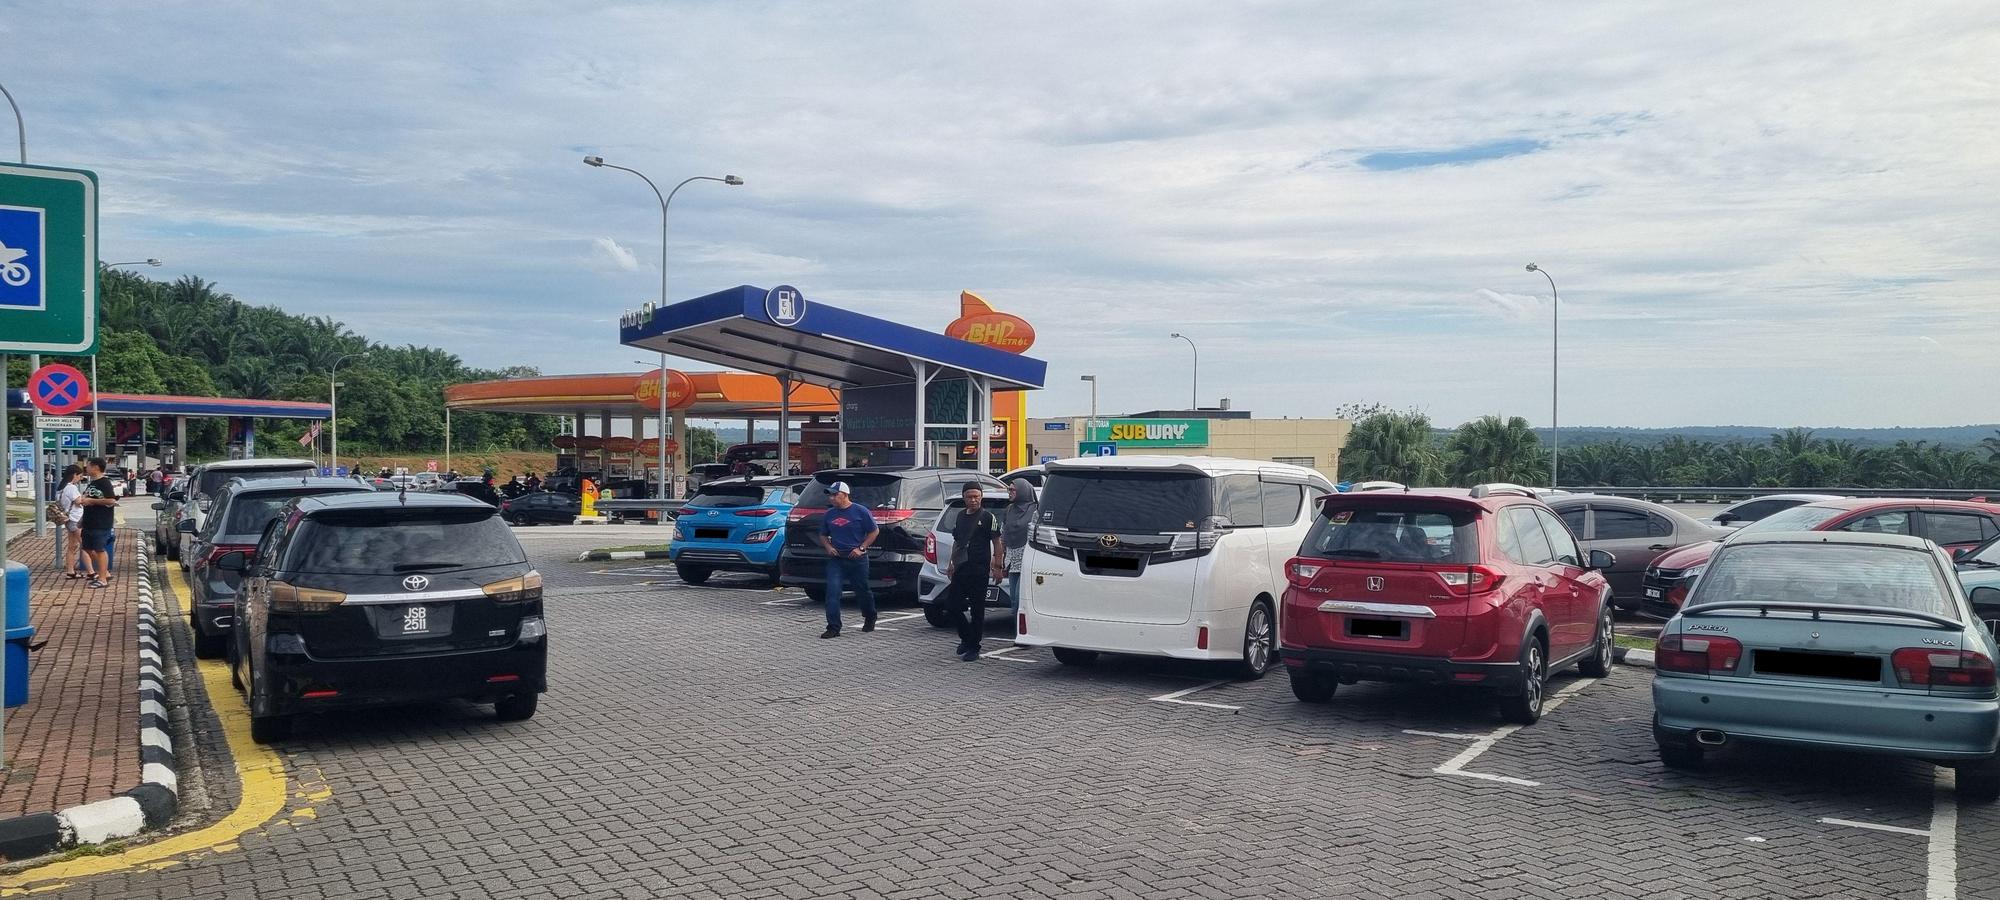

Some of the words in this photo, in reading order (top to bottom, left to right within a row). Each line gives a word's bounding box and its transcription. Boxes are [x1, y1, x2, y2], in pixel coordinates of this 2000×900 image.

[1111, 423, 1190, 440] SUBWAY
[63, 435, 71, 445] P
[404, 607, 426, 619] JSB
[404, 618, 426, 630] 2511
